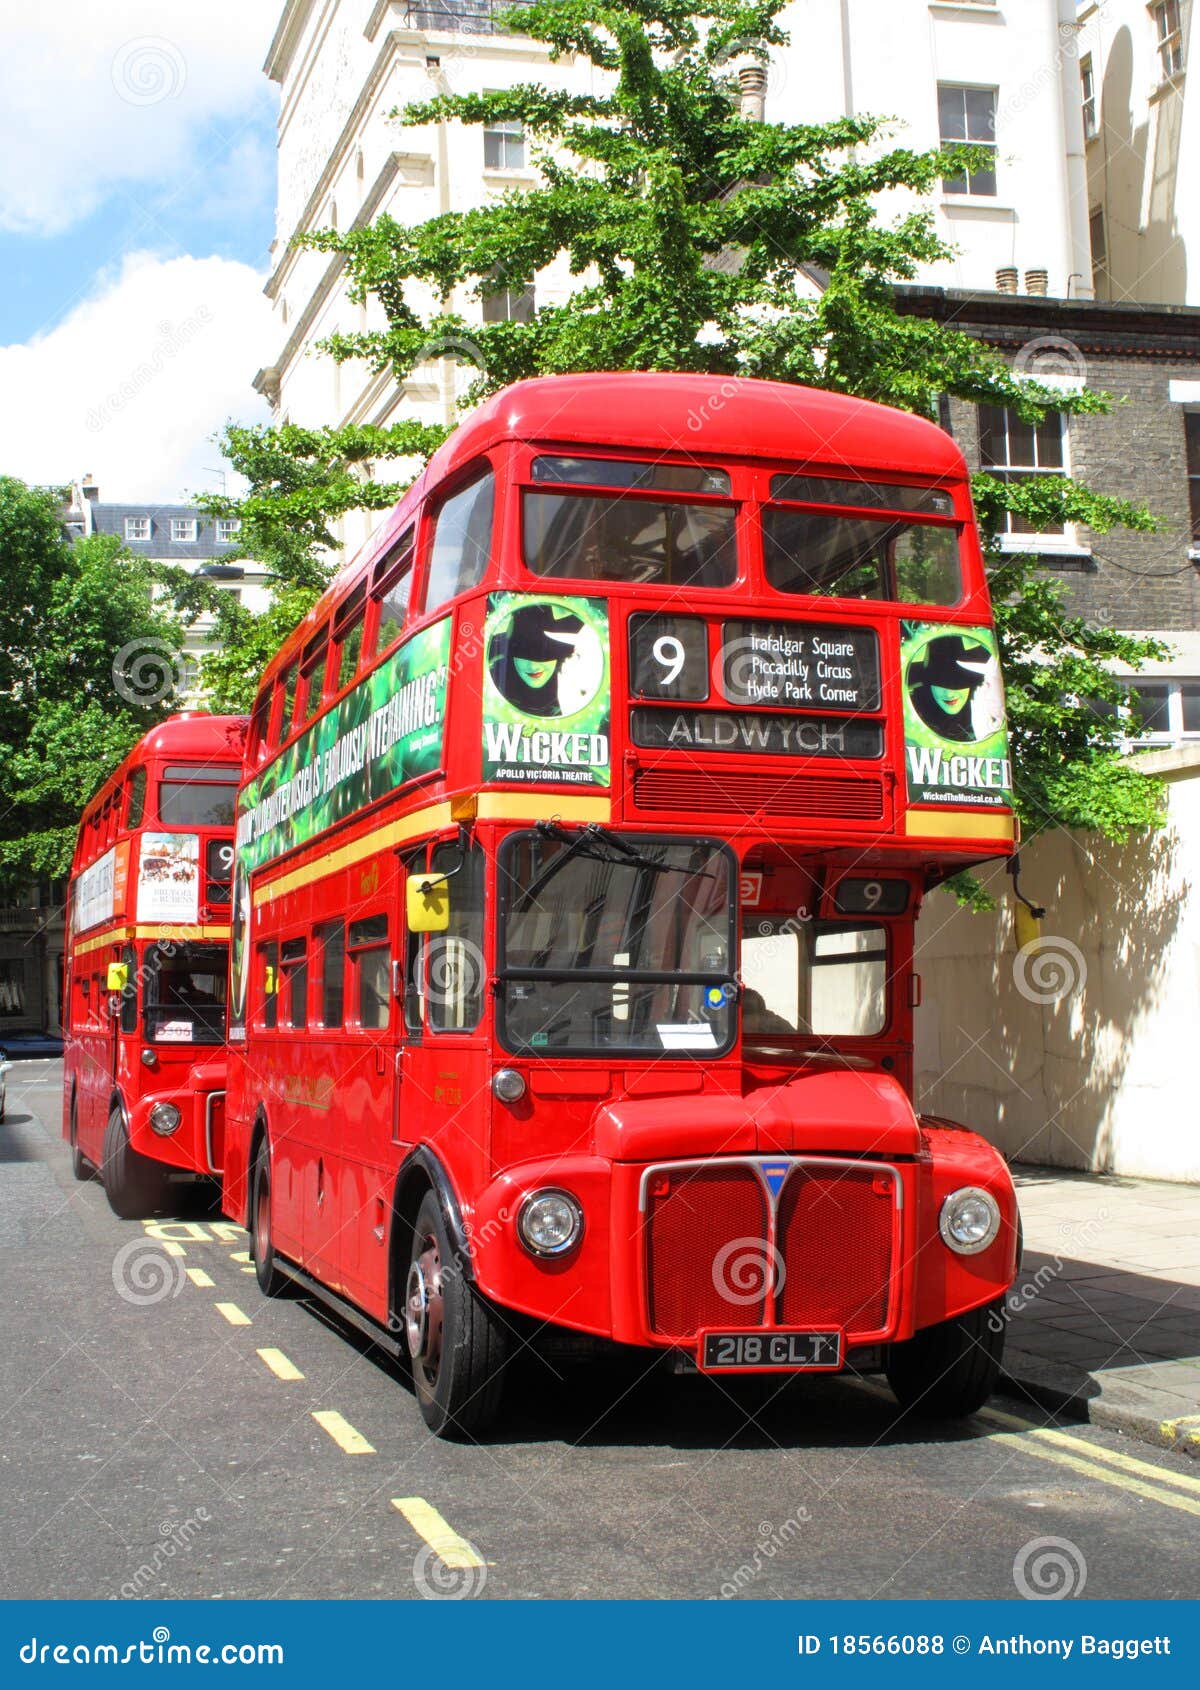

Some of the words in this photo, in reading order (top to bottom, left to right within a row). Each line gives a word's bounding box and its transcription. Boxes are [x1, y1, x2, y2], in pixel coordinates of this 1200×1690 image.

[750, 632, 804, 656] Trafalgar
[812, 637, 854, 659] Square
[653, 635, 685, 685] 9
[752, 656, 809, 681] Piccadilly
[816, 661, 852, 680] Circus
[747, 680, 779, 701] Hyde
[785, 682, 813, 700] Park
[820, 684, 858, 702] Corner
[667, 715, 844, 751] ALDWYCH
[496, 768, 524, 779] APOLLO
[526, 769, 560, 780] VICTORIA
[562, 771, 593, 781] THEATRE
[922, 792, 1003, 804] WickedTheMusical.co.uk
[218, 846, 234, 870] 9
[863, 882, 882, 911] 9
[716, 1337, 763, 1364] 218
[769, 1336, 827, 1363] CLT
